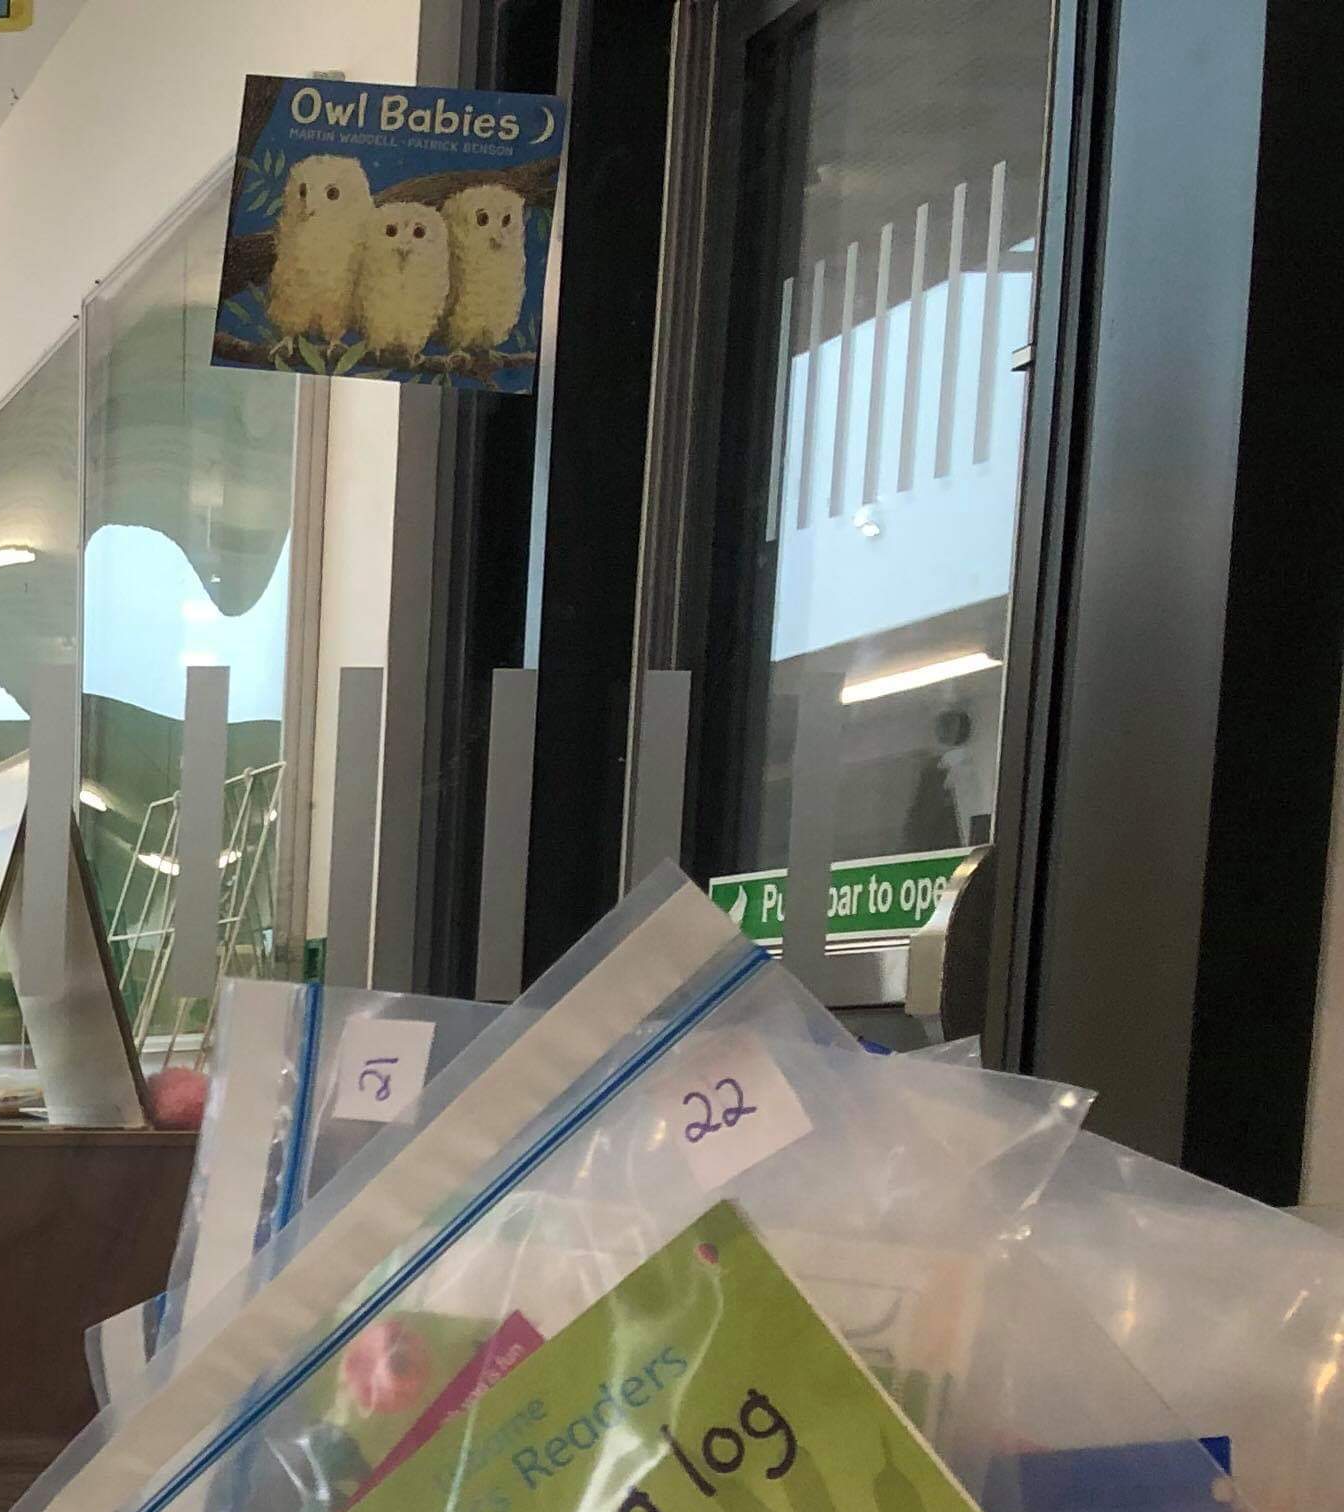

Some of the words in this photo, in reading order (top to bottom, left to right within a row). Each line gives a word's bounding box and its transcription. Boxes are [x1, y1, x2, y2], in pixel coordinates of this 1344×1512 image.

[291, 87, 369, 129] Owl
[380, 95, 520, 140] Babies
[868, 874, 893, 914] to
[900, 876, 948, 920] ope
[682, 1077, 758, 1145] 22
[513, 1345, 690, 1490] Readers
[659, 1388, 798, 1498] log
